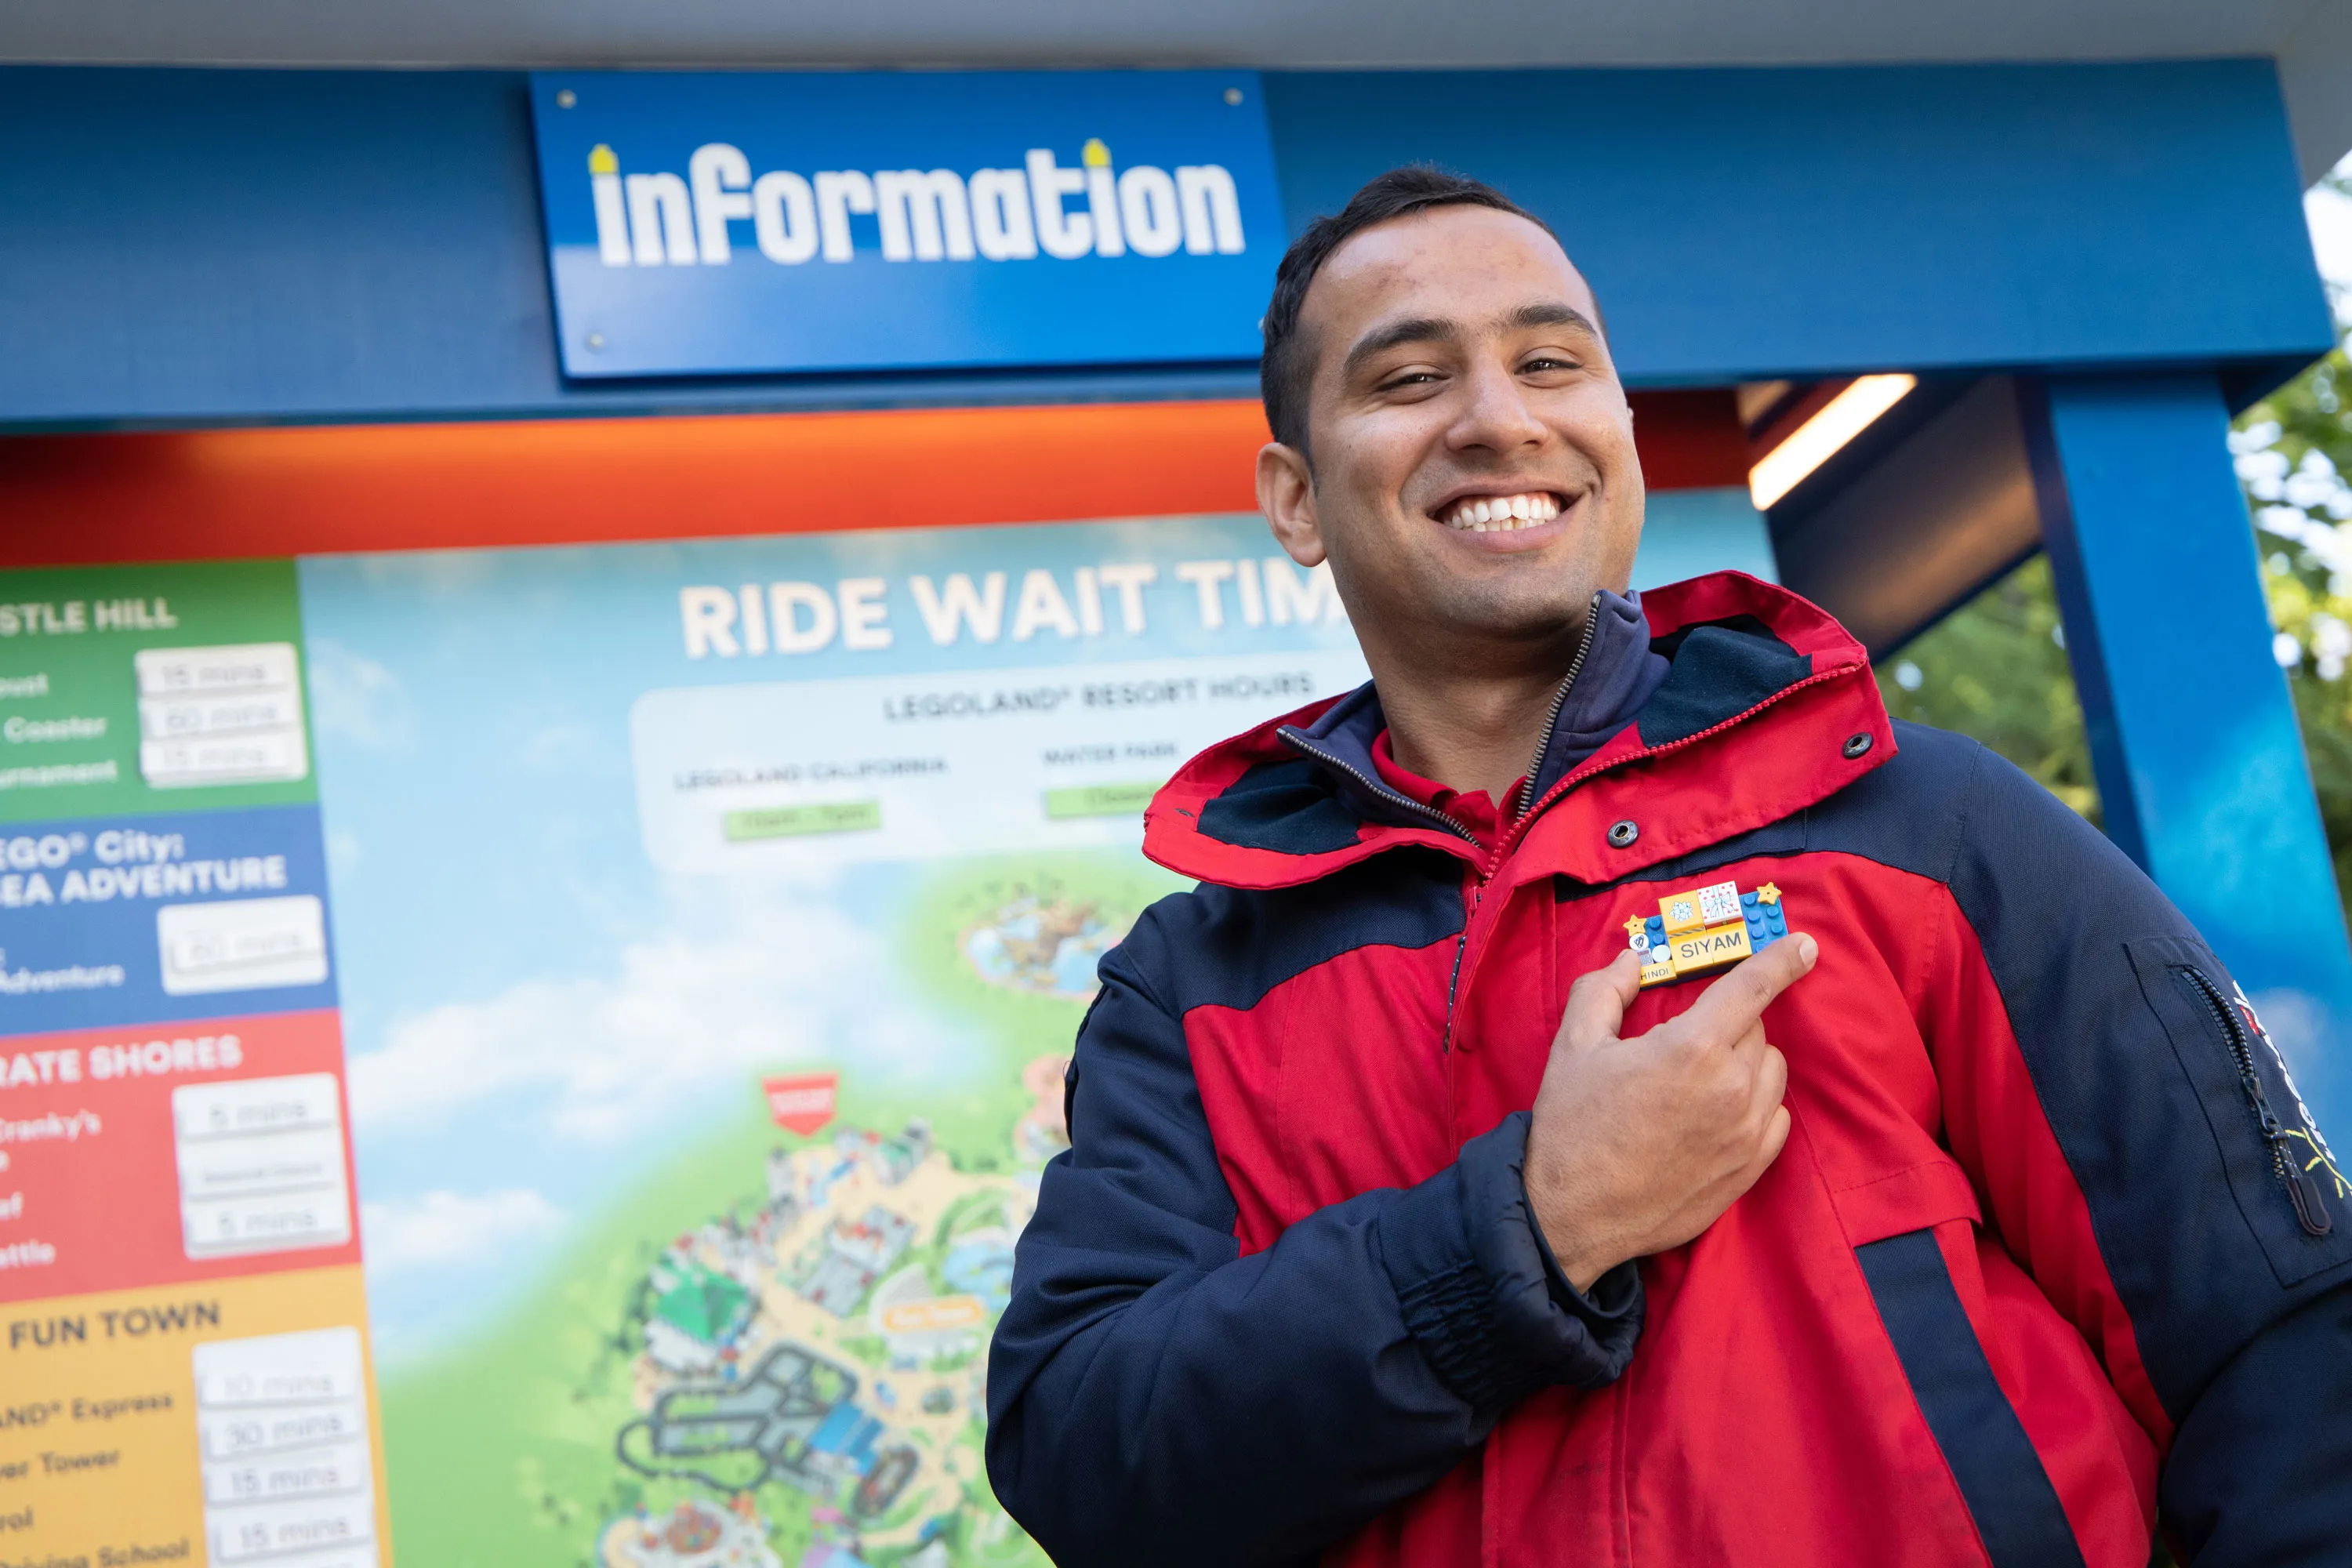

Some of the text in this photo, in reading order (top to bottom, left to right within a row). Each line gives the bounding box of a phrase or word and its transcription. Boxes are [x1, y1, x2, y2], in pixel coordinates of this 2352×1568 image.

[590, 138, 1246, 267] information
[94, 596, 178, 632] HILL
[679, 557, 1347, 659] RIDE WAIT TIM
[1082, 677, 1200, 710] RESORT
[1210, 672, 1315, 699] HOURS
[4, 715, 108, 744] Coaster
[60, 855, 287, 904] ADVENTURE
[1681, 931, 1742, 958] SIYAM
[1640, 967, 1669, 981] HINDI
[89, 1034, 242, 1080] SHORES
[9, 1300, 220, 1351] FUN TOWN
[72, 1392, 173, 1421] Express
[272, 1414, 343, 1441] mins
[40, 1450, 121, 1475] Tower
[269, 1466, 341, 1492] mins
[278, 1515, 350, 1543] mins
[98, 1535, 190, 1568] School
